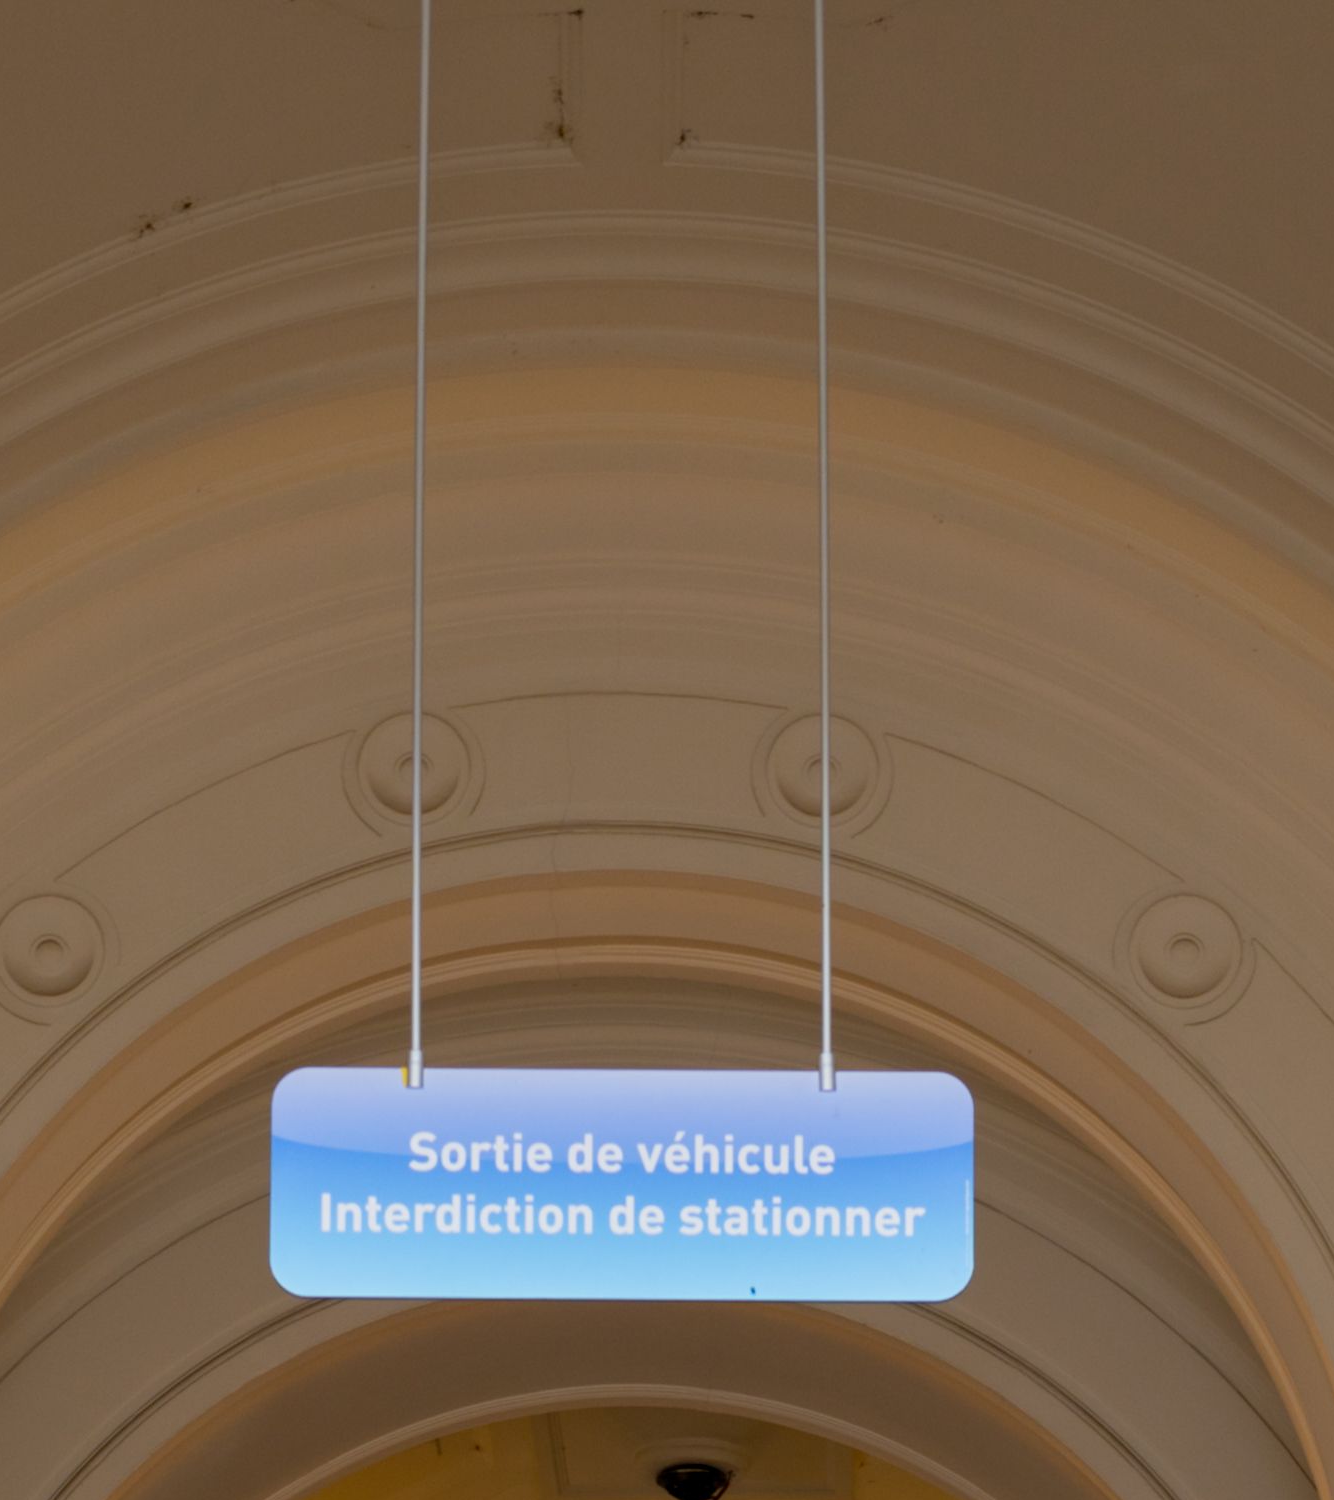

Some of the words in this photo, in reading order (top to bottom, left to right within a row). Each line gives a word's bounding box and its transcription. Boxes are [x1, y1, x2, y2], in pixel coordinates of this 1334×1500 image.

[408, 1130, 554, 1174] Sortie
[566, 1132, 624, 1174] de
[636, 1130, 837, 1176] véhicule
[319, 1192, 595, 1236] Interdiction
[607, 1195, 666, 1237] de
[679, 1198, 926, 1239] stationner
